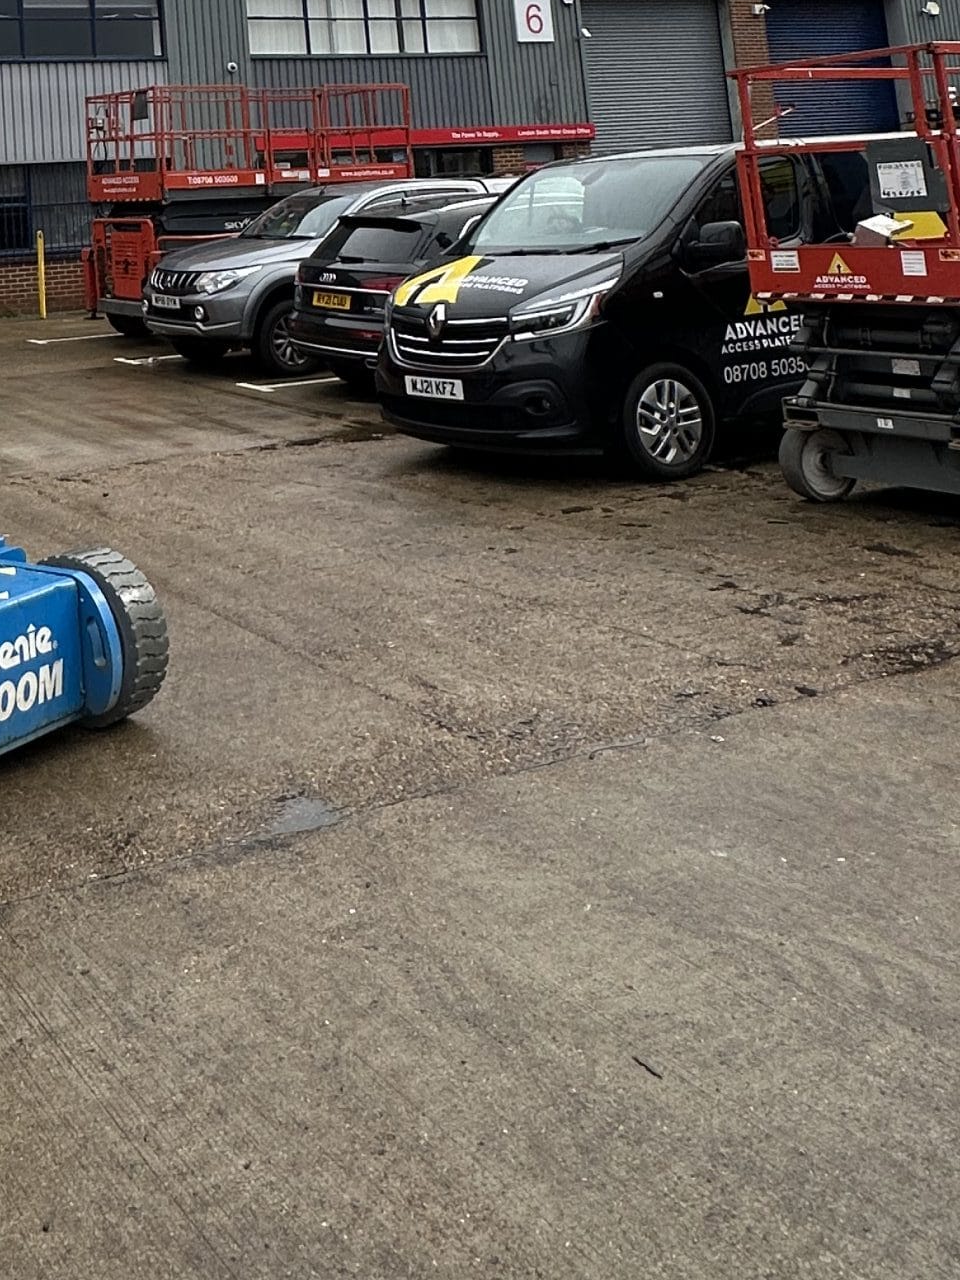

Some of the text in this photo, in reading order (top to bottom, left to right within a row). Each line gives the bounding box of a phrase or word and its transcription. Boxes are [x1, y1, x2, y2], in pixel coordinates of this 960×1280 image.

[526, 4, 544, 34] 6
[815, 275, 867, 284] ADVANCED
[721, 337, 761, 354] ACCESS
[723, 361, 767, 384] 08708
[435, 380, 457, 396] KFZ
